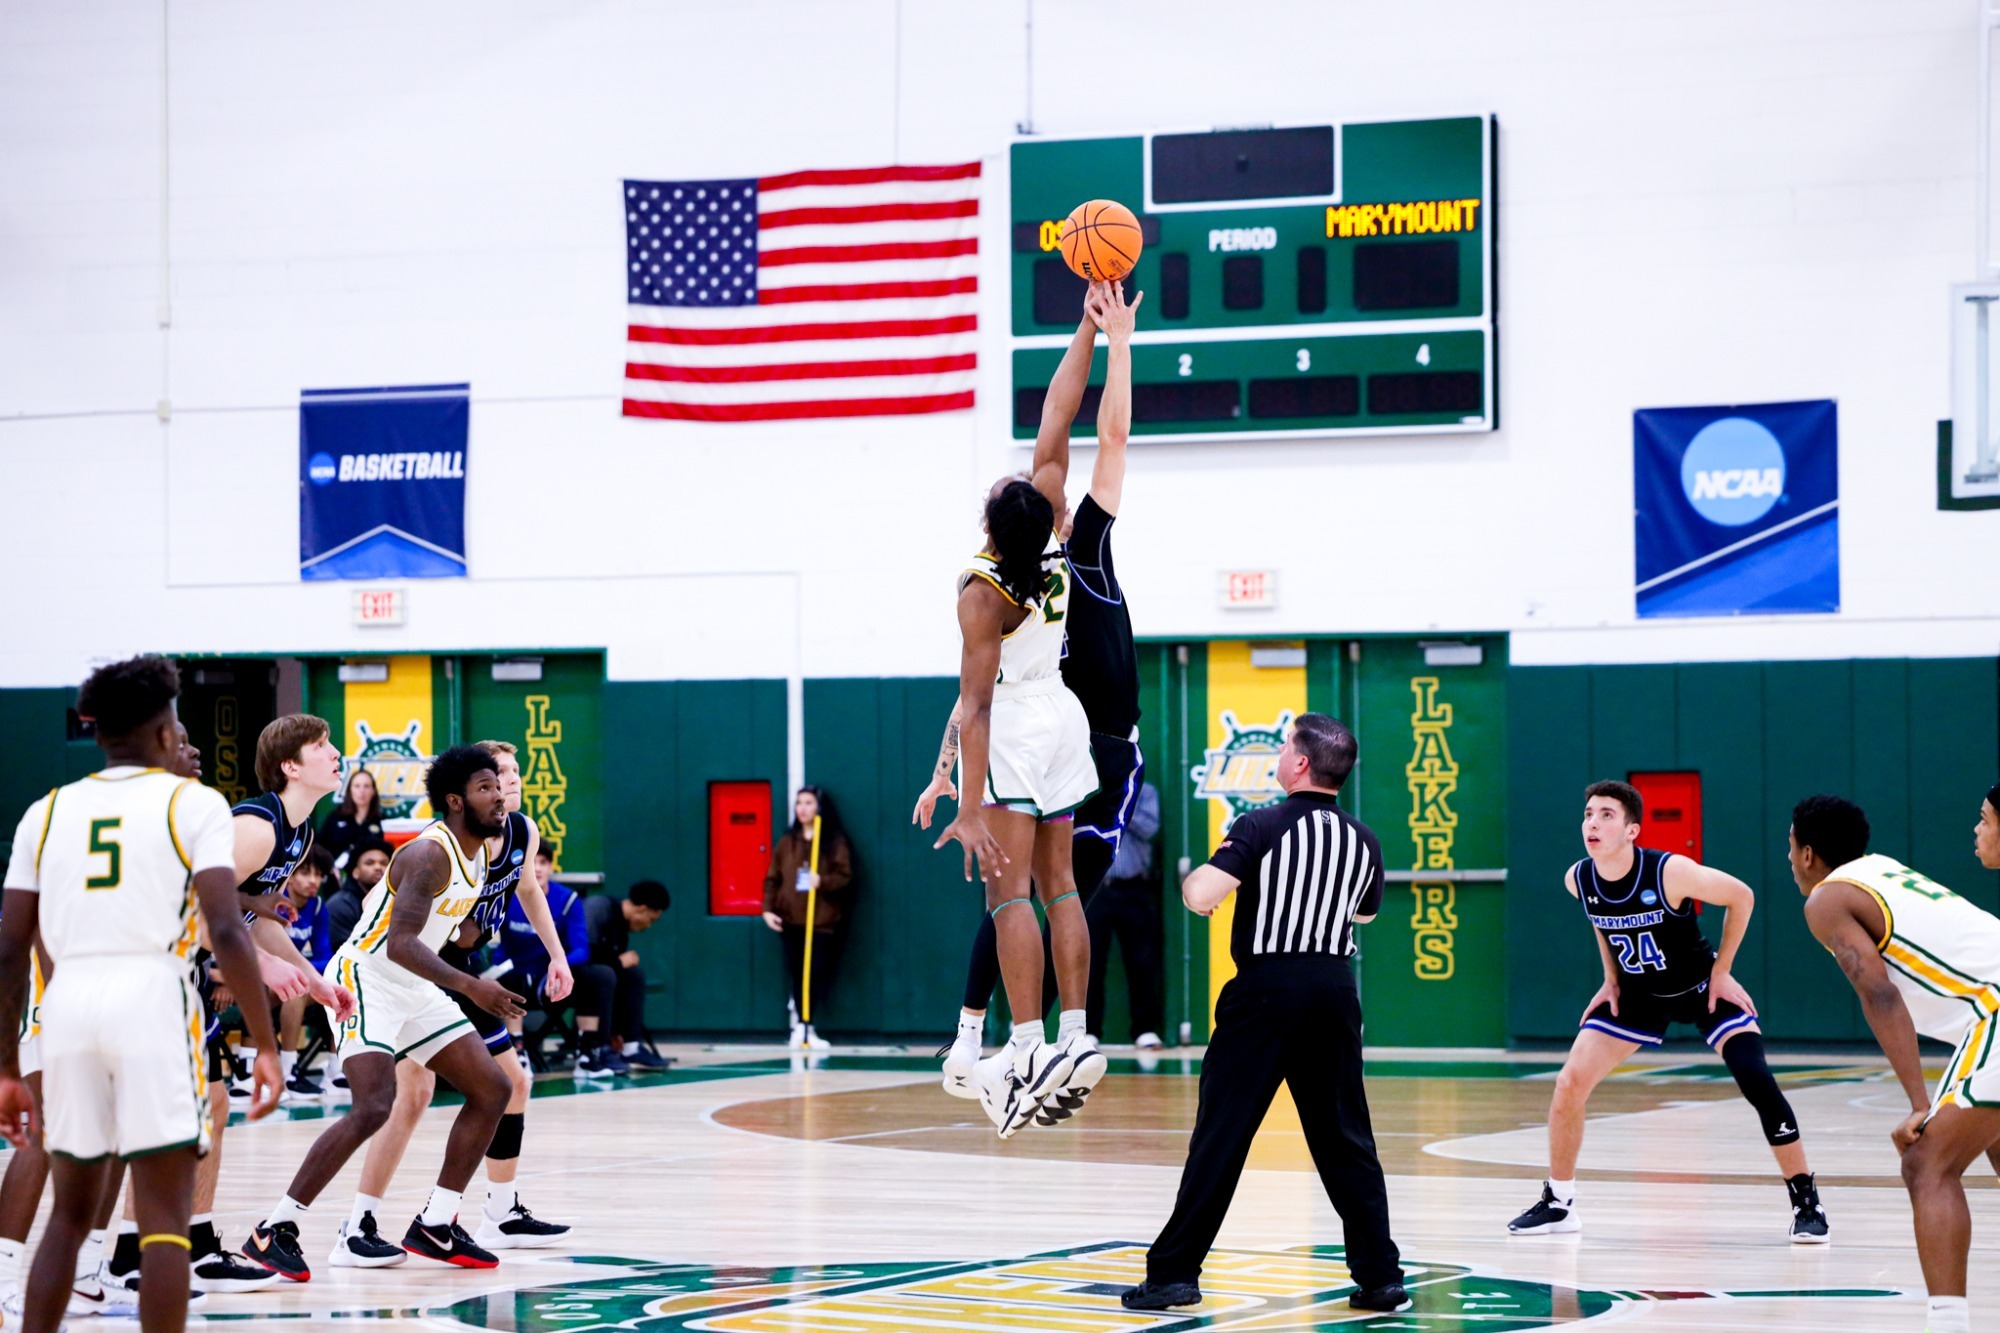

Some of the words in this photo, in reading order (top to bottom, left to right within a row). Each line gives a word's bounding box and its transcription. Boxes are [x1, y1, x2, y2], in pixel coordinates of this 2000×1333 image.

[1326, 199, 1480, 238] MARYMOUNT
[1208, 227, 1277, 252] PERIOD
[1178, 353, 1193, 376] 2
[1296, 349, 1311, 371] 3
[1415, 344, 1431, 367] 4
[338, 451, 464, 482] BASKETBALL
[1693, 468, 1782, 500] NCAA
[361, 591, 394, 619] EXIT
[1406, 677, 1458, 980] LAKERS
[86, 816, 122, 890] 5
[474, 892, 506, 937] 14
[1589, 909, 1665, 930] MARYMOUNT
[1608, 931, 1667, 974] 24
